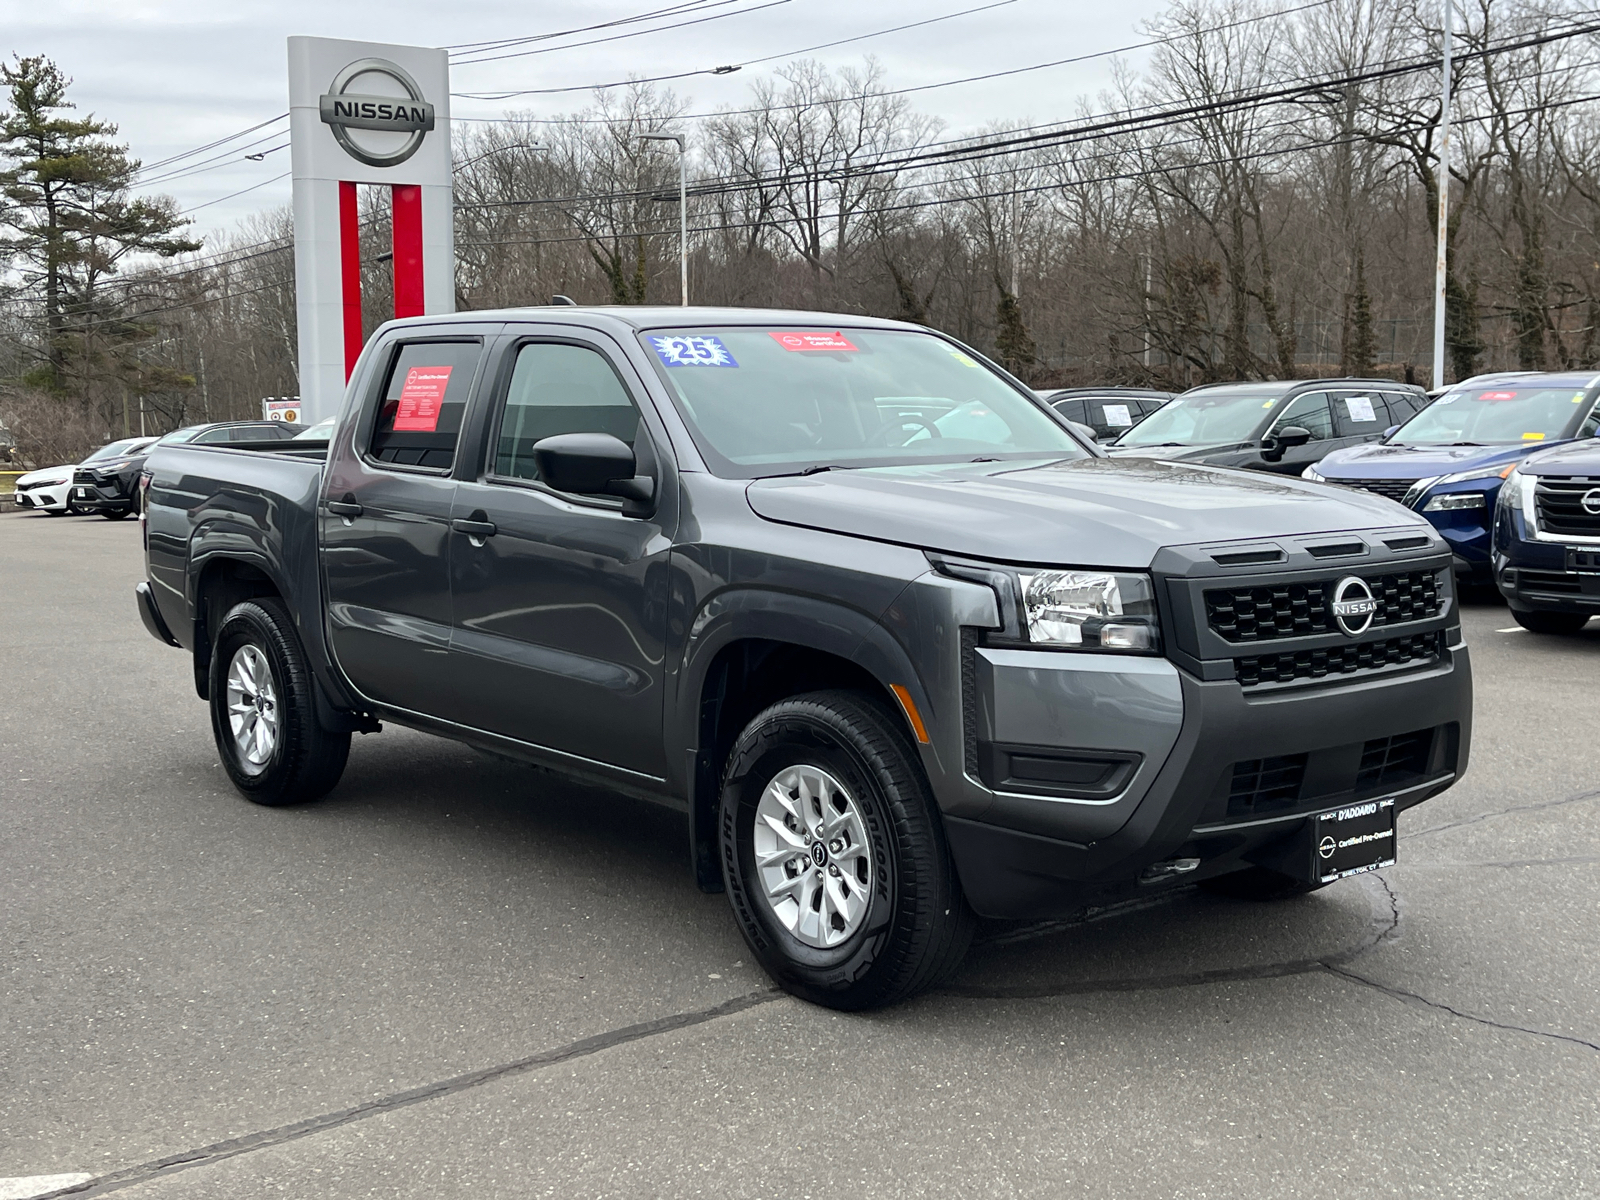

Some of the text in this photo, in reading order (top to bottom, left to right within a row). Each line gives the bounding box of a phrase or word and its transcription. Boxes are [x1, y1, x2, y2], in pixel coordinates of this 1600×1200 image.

[334, 101, 425, 123] NISSAN
[672, 341, 712, 359] 25
[1335, 602, 1377, 614] NISSAN
[1338, 803, 1377, 821] D'ADDARIO
[1338, 829, 1393, 848] Certified Pre-Owned
